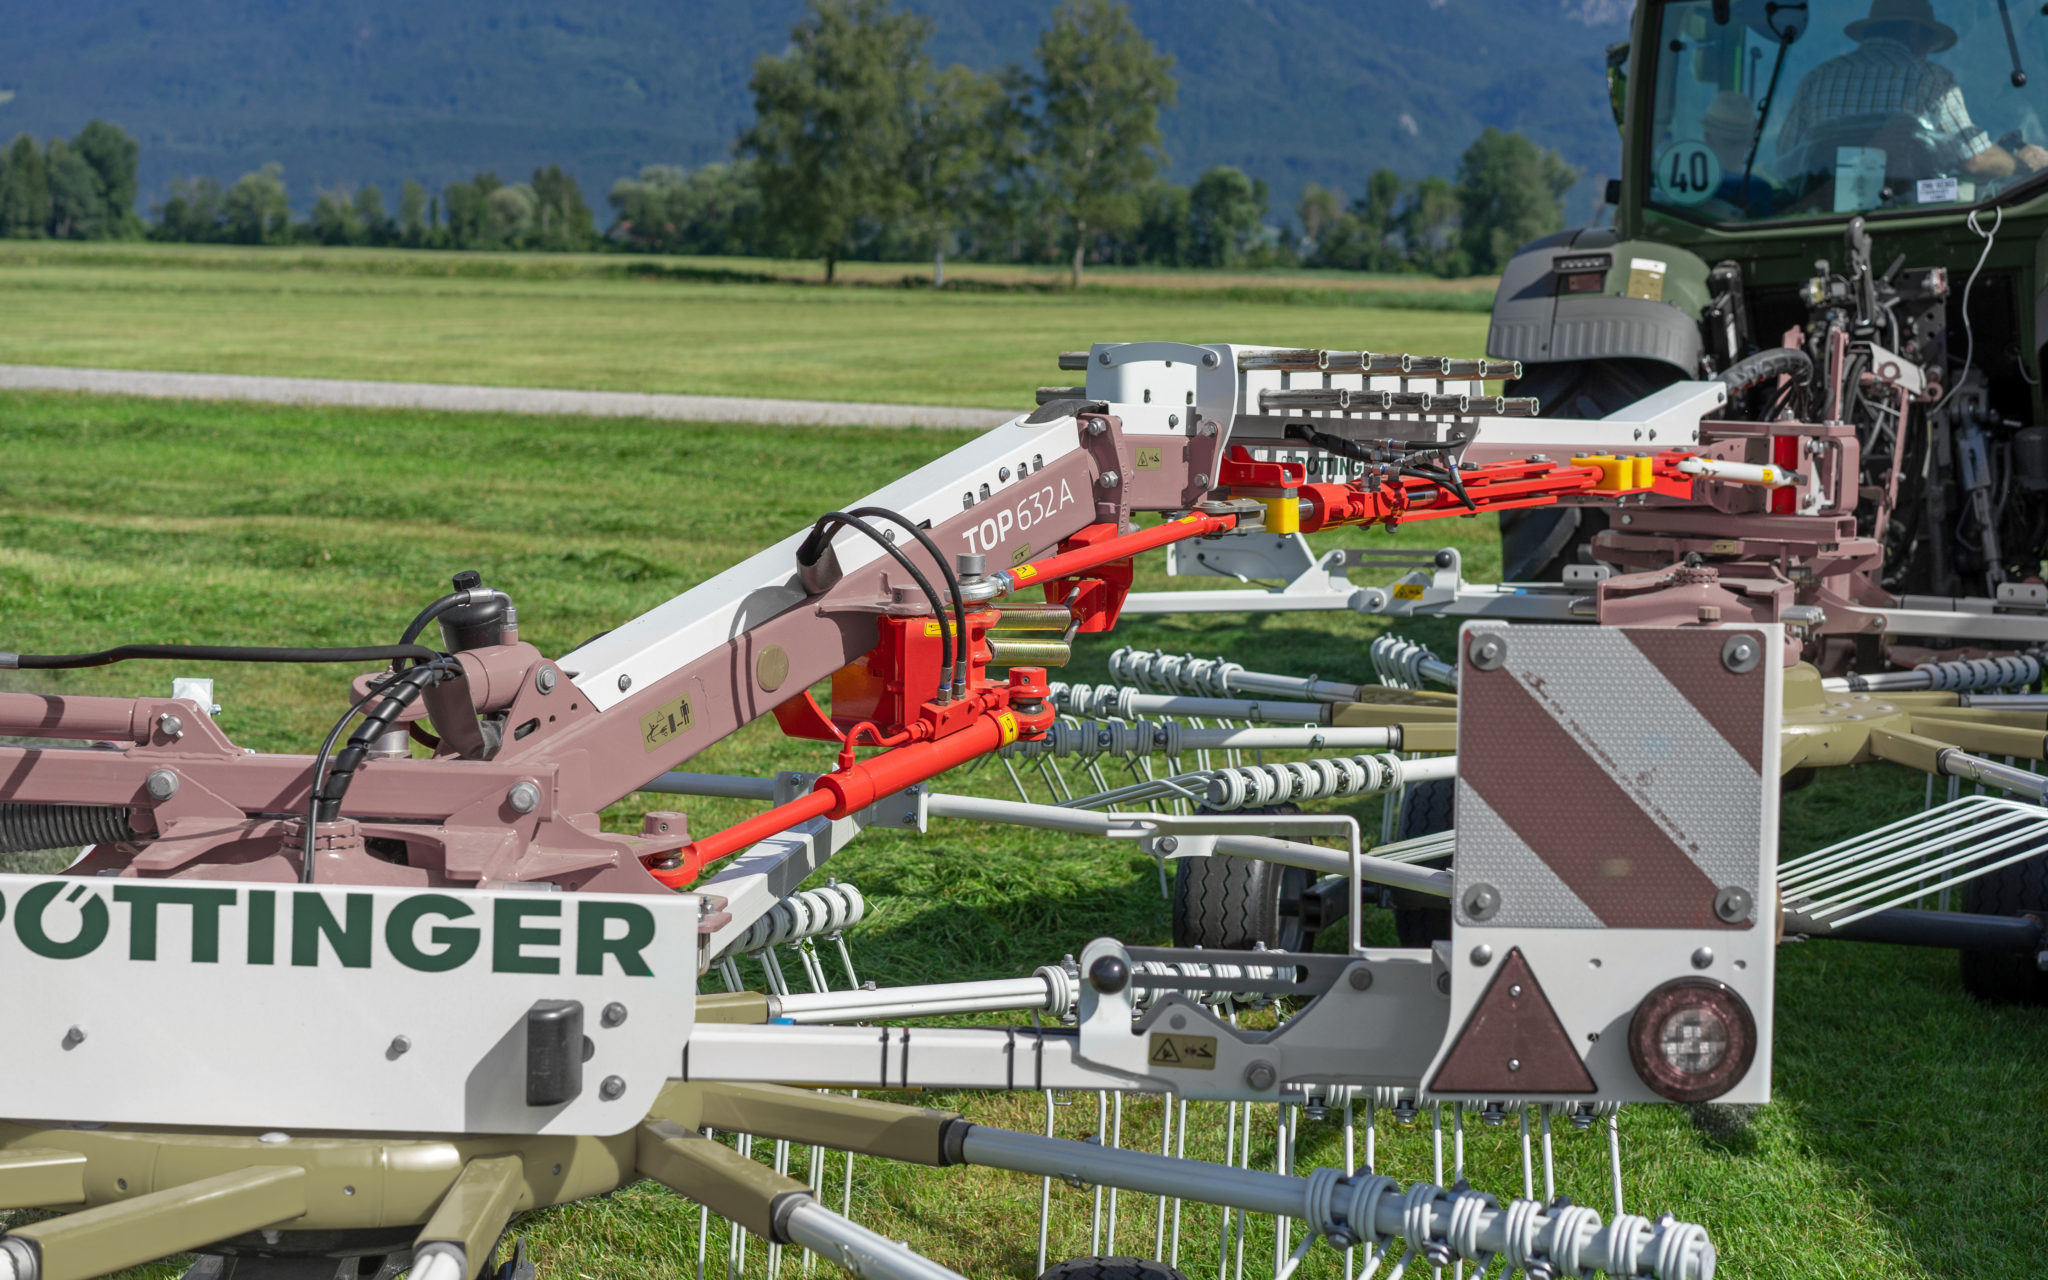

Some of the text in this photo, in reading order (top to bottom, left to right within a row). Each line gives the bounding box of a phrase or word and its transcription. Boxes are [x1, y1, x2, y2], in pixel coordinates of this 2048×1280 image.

[1669, 150, 1709, 193] 40
[962, 509, 1014, 554] TOP
[0, 881, 657, 978] ÖTTINGER
